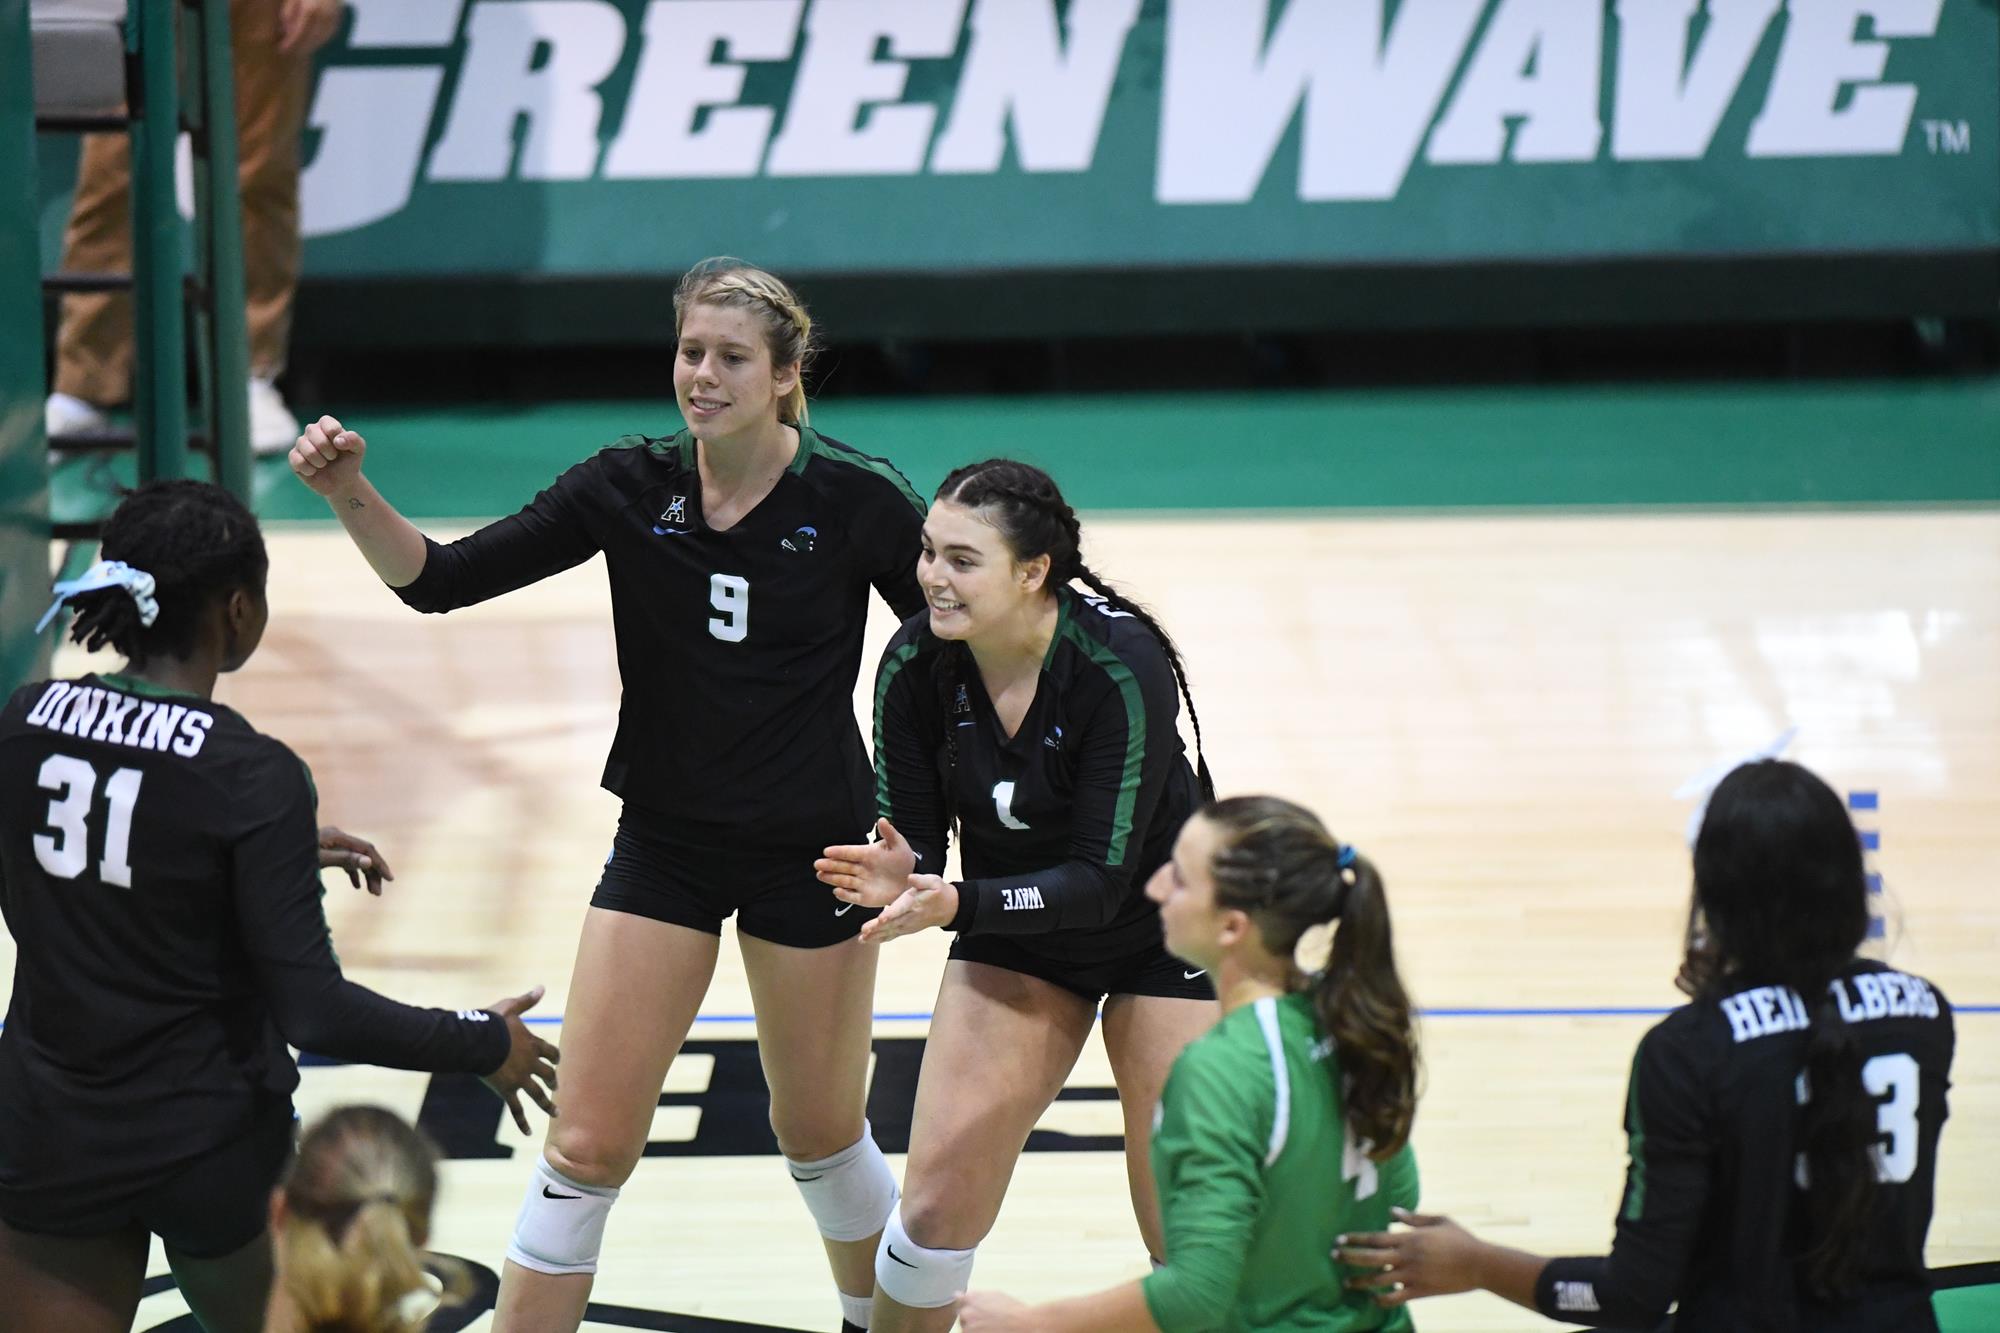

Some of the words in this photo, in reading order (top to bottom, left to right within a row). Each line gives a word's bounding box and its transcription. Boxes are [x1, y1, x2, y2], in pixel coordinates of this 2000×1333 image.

[1922, 119, 1971, 155] TM
[708, 573, 750, 643] 9
[26, 680, 214, 758] DINKINS
[33, 754, 144, 889] 31
[992, 781, 1032, 830] 1
[1001, 886, 1045, 911] WAVE
